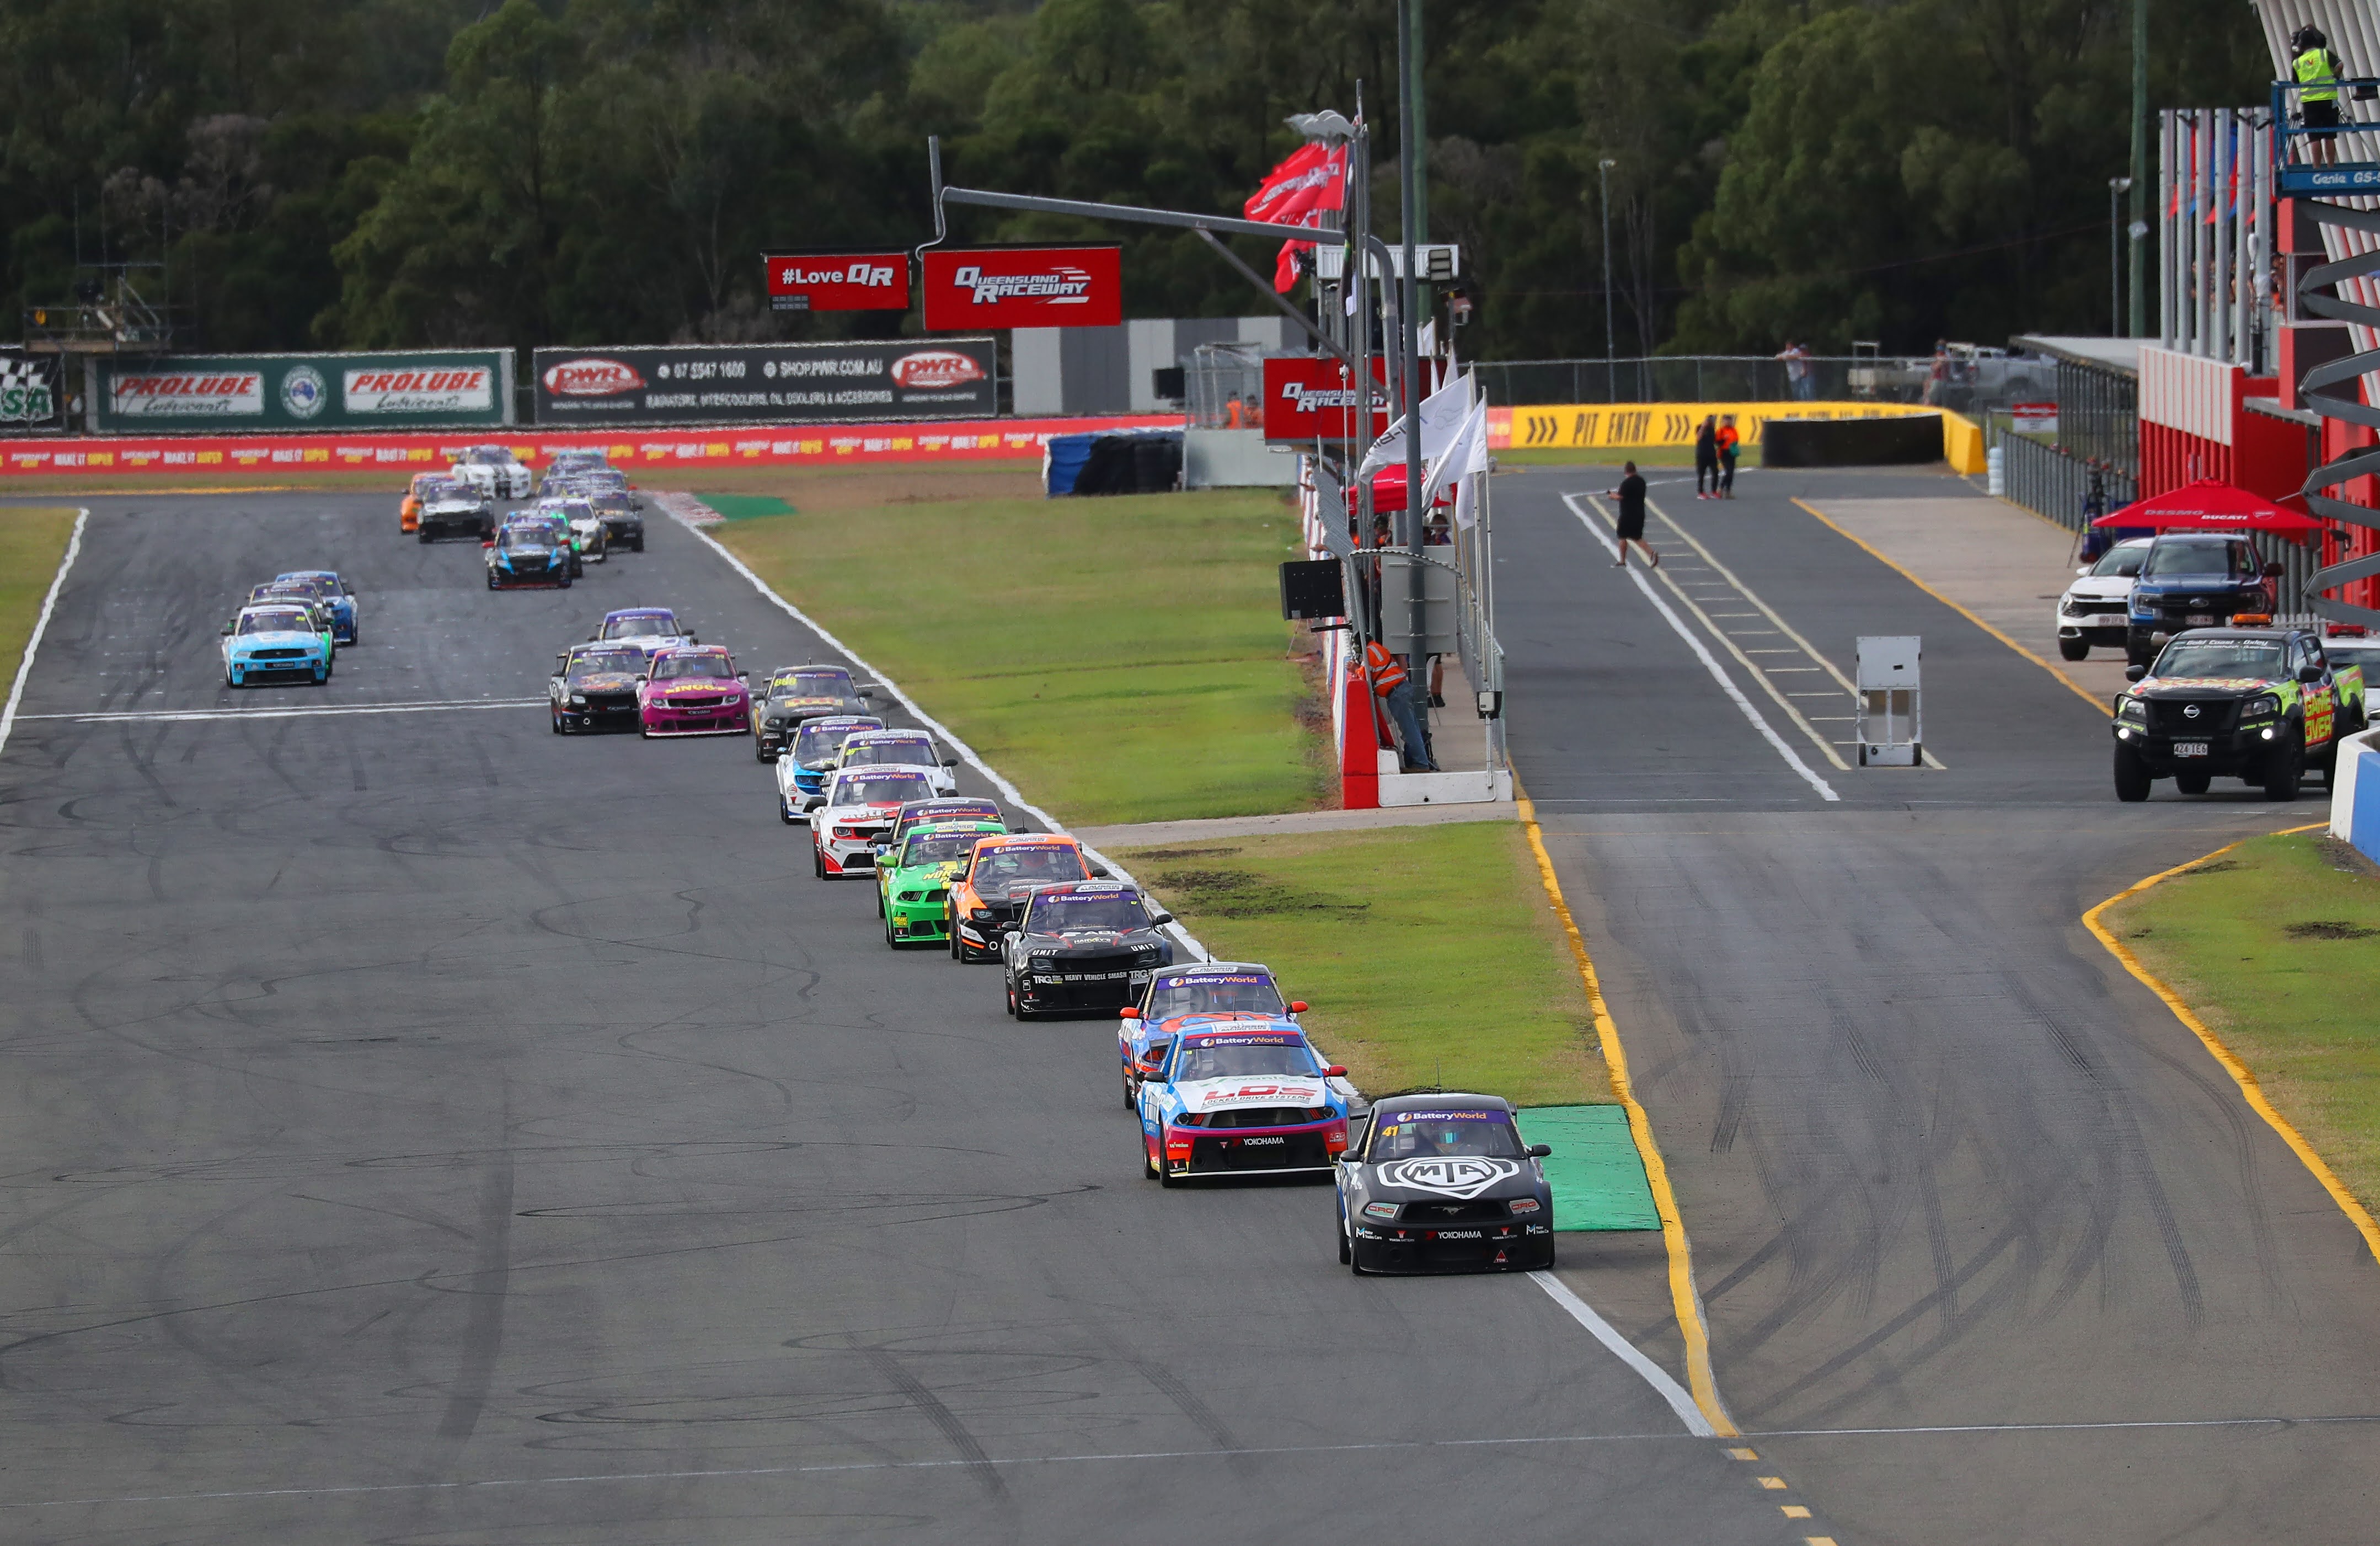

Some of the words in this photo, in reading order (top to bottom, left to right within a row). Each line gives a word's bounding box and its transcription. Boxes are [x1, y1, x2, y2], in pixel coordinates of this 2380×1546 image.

[955, 266, 1060, 288] QUEENSLAND
[972, 283, 1087, 303] RACEWAY
[352, 372, 485, 392] PROLUBE
[554, 367, 622, 395] PWR
[896, 359, 964, 388] PWR
[116, 376, 258, 396] PROLUBE
[1282, 382, 1357, 399] QUEENSLAN
[1573, 413, 1598, 445] PIT
[1607, 411, 1652, 443] ENTRY
[2174, 745, 2188, 753] 424
[1131, 943, 1156, 951] UNIT
[1205, 1085, 1318, 1100] LDS
[1413, 1112, 1486, 1121] BatteryWorld
[1382, 1125, 1399, 1137] 41
[1438, 1231, 1482, 1239] YOKOHAMA
